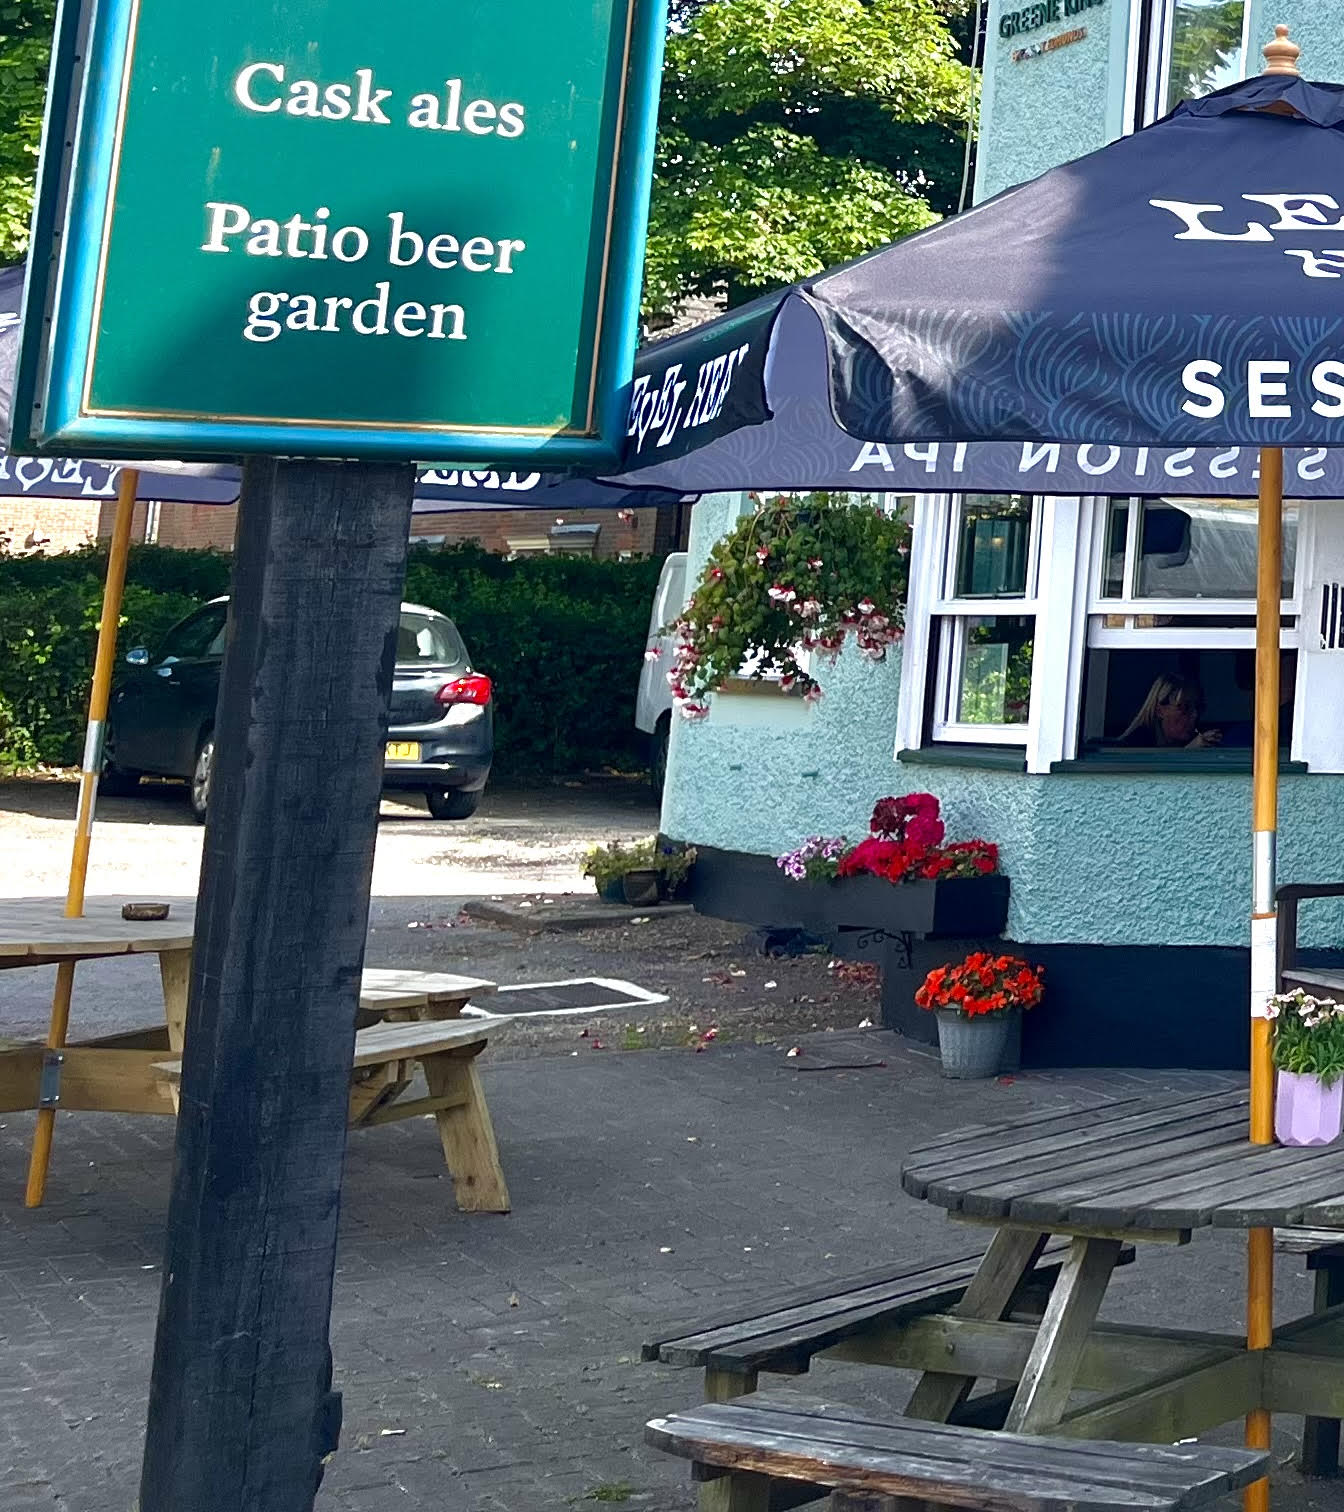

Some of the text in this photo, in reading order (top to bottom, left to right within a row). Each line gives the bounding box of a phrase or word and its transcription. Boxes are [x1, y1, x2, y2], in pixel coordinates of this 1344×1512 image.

[235, 63, 527, 139] Cask ales
[201, 202, 526, 275] Patio beer
[244, 283, 468, 342] garden
[626, 363, 687, 455] EVEL
